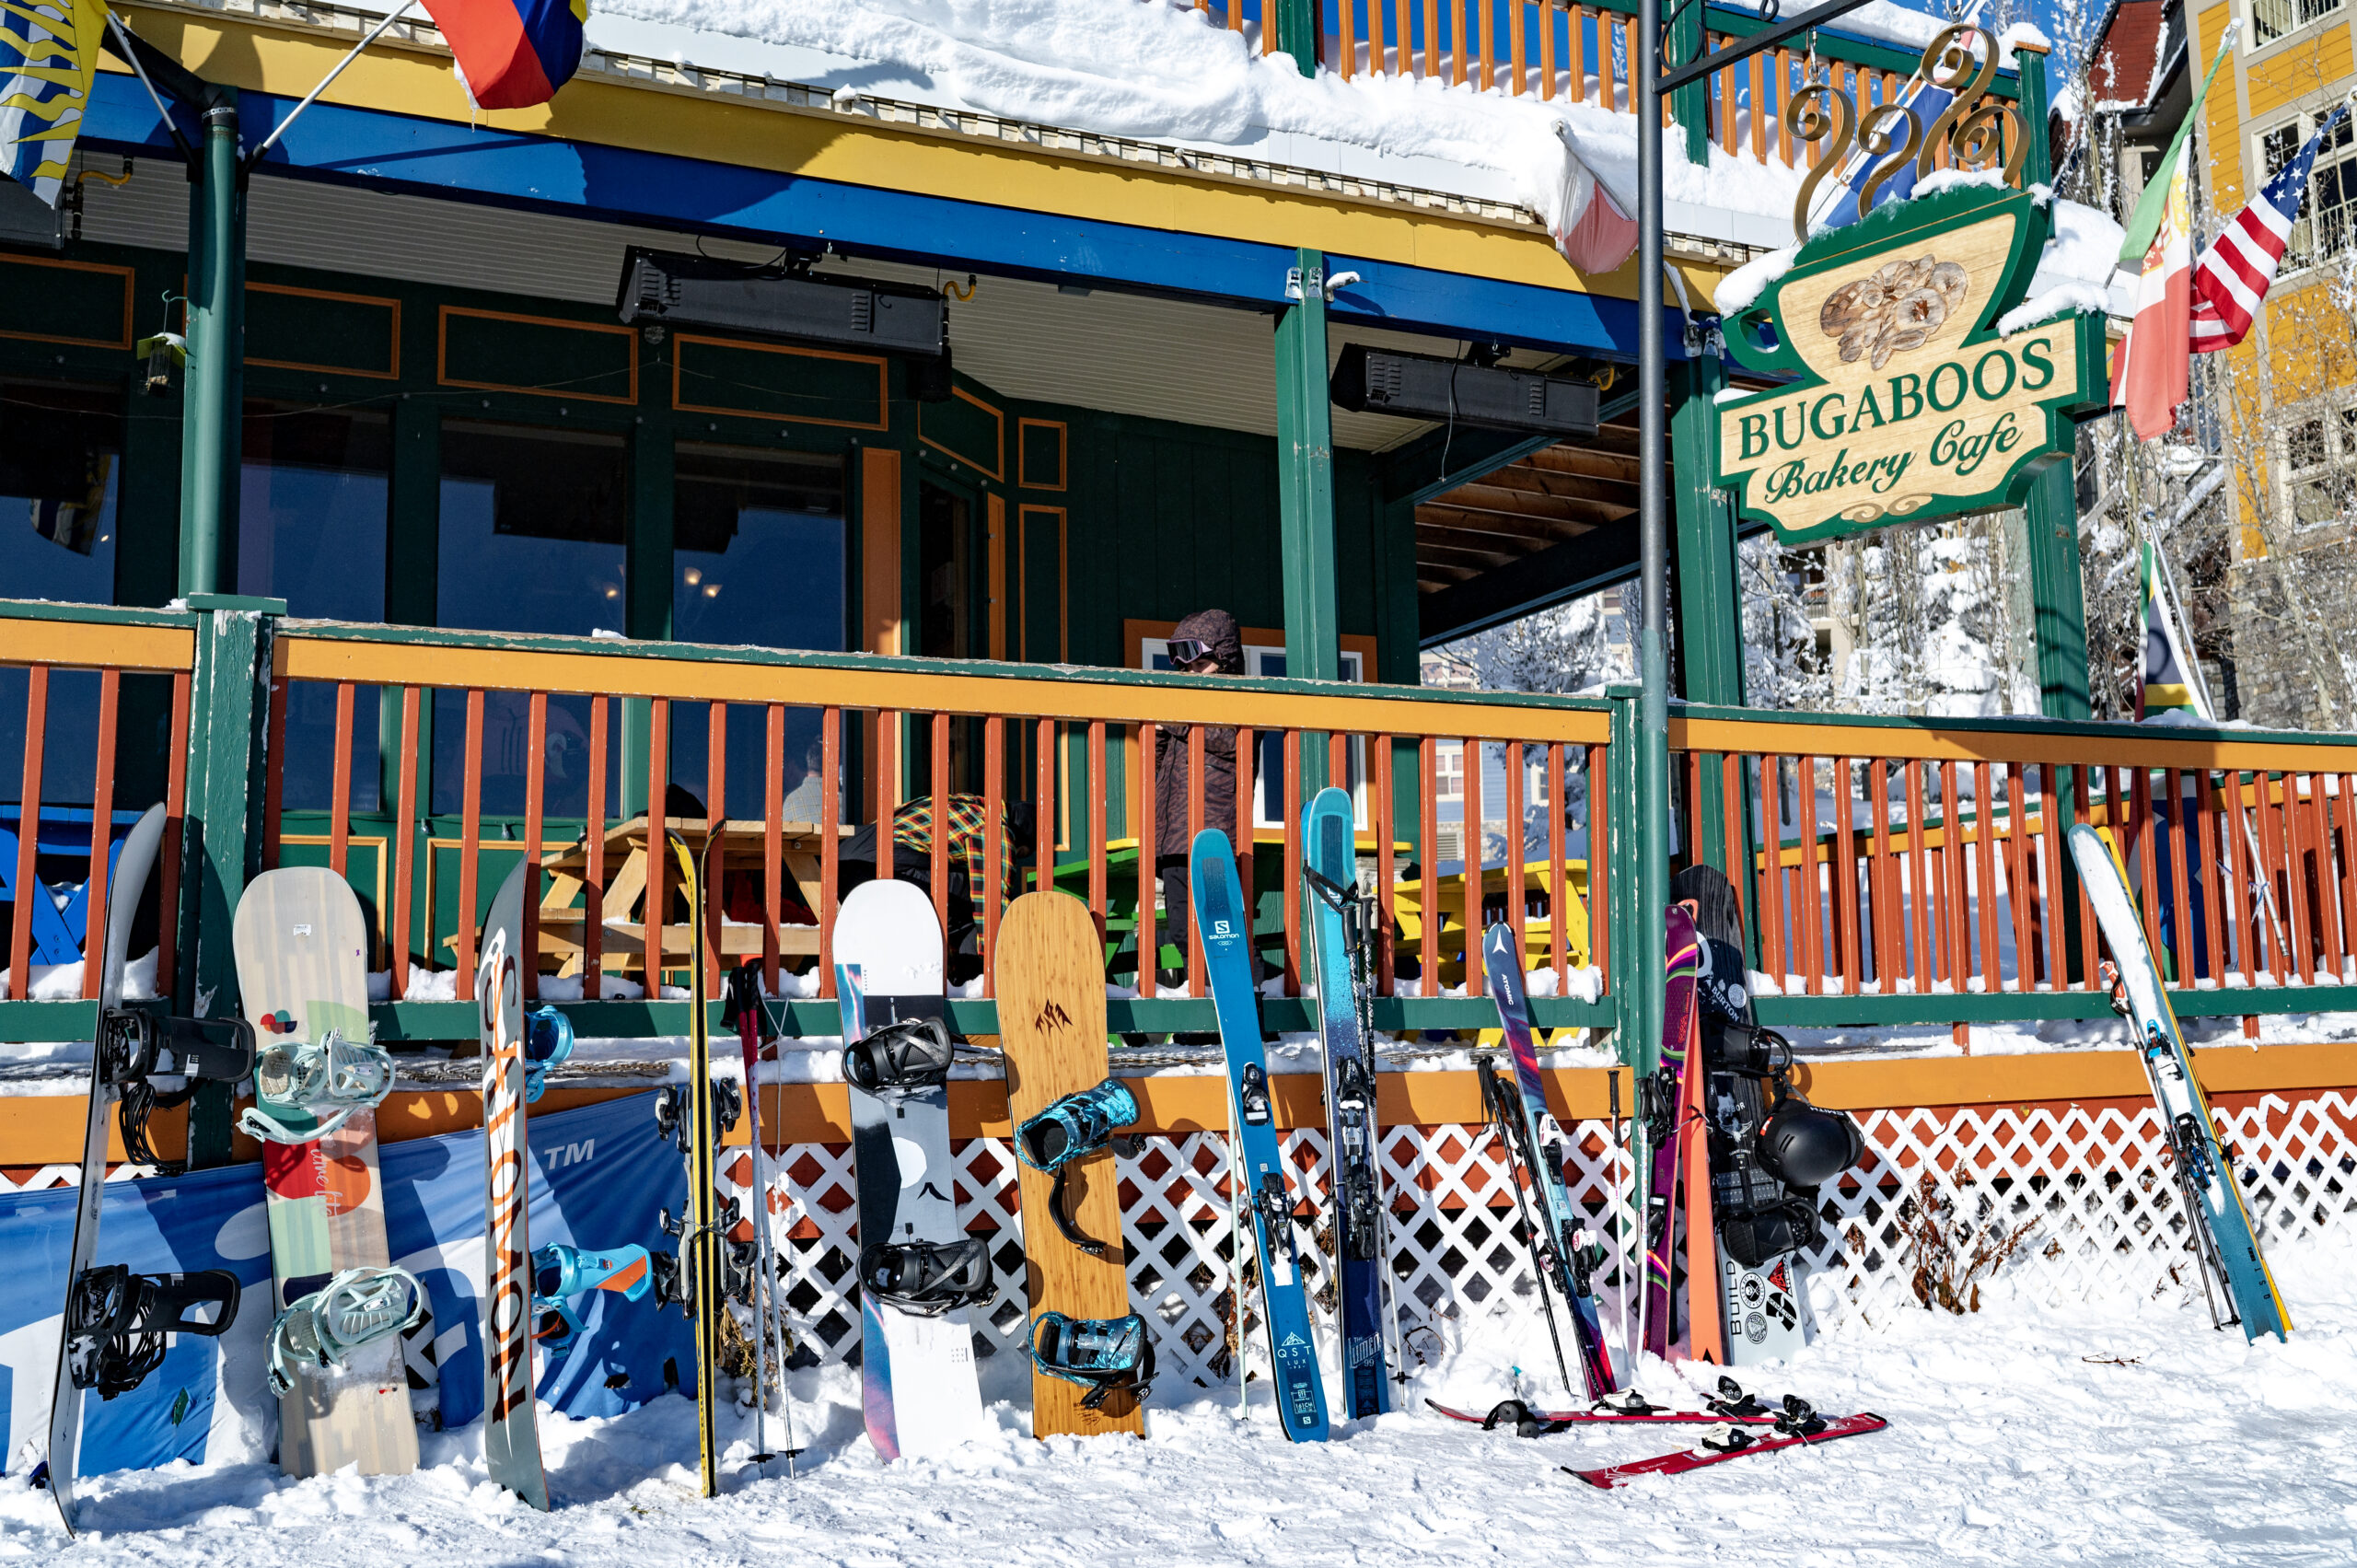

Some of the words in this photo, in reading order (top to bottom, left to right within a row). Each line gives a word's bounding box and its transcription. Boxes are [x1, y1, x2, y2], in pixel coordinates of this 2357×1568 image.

[1738, 338, 2055, 461] BUGABOOS
[1764, 448, 1917, 504] Bakery
[1930, 412, 2024, 476] Cafe
[1502, 973, 1515, 1005] ATOMIC
[1712, 985, 1740, 1022] BURTON
[1809, 1106, 1845, 1116] SMITH
[544, 1138, 595, 1170] TM
[483, 955, 526, 1425] SALOMON
[1725, 1260, 1742, 1336] BUILD
[1277, 1345, 1311, 1358] QST
[1363, 1358, 1375, 1366] 99
